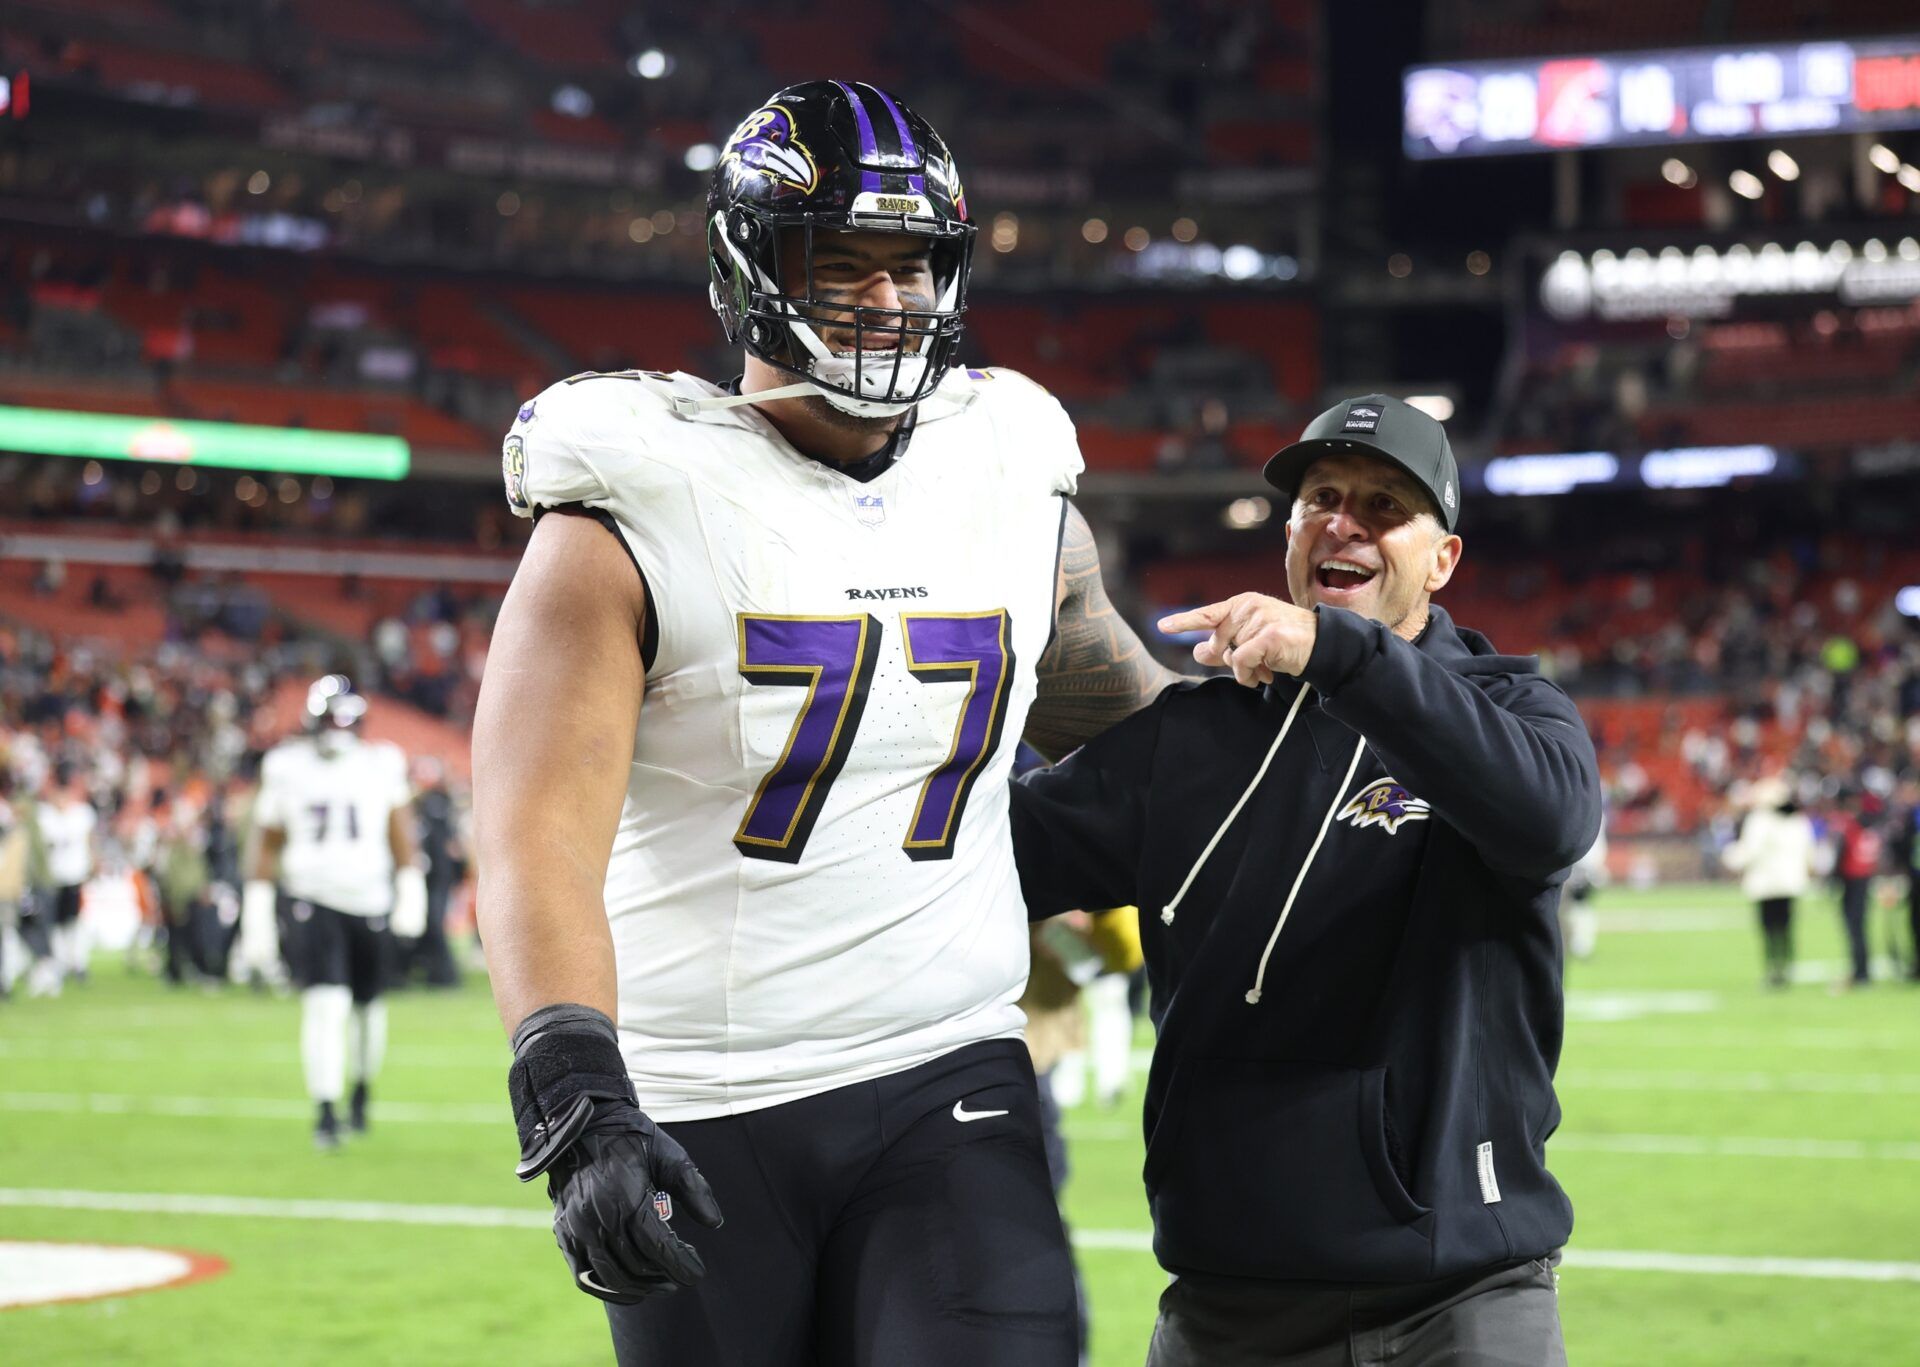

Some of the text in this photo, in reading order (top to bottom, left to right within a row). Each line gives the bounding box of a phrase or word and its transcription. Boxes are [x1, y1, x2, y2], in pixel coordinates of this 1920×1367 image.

[876, 197, 920, 213] RAVENS
[845, 586, 929, 601] RAVENS
[732, 607, 1016, 865] 77
[1368, 786, 1392, 811] B
[306, 804, 360, 842] 71
